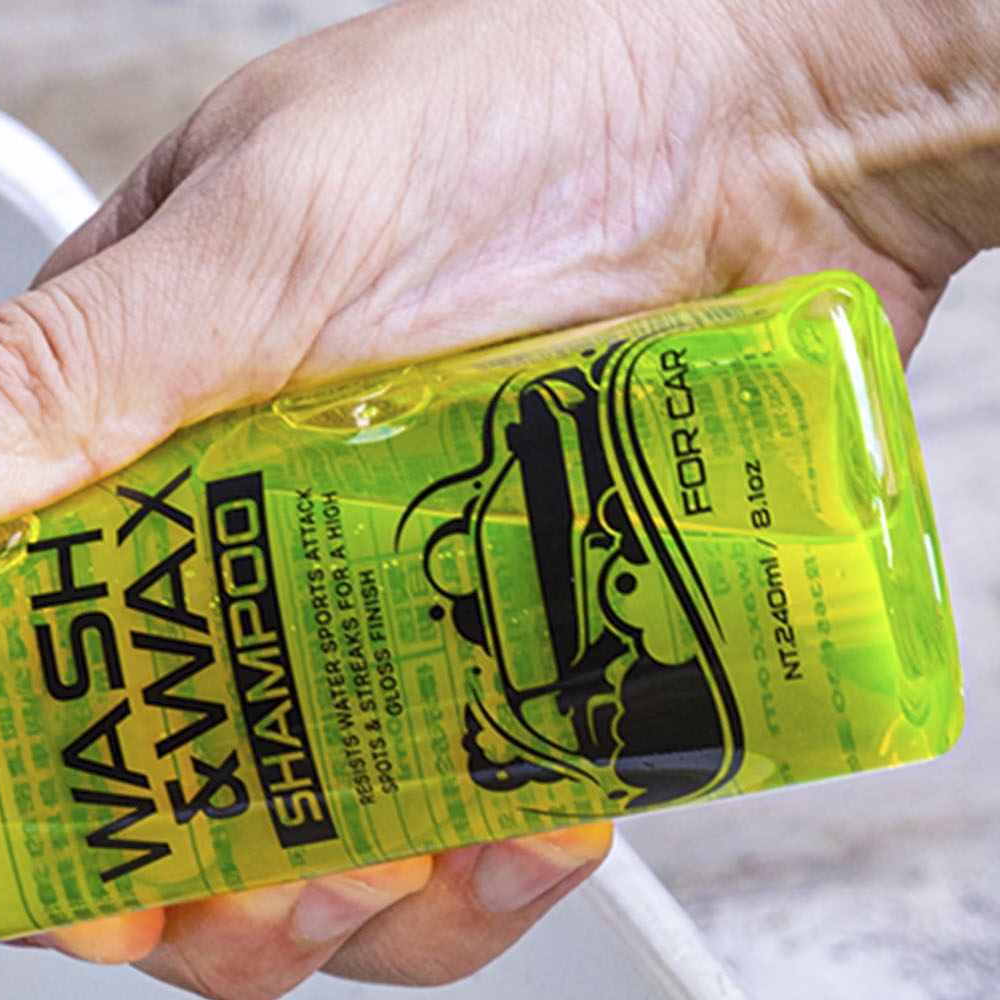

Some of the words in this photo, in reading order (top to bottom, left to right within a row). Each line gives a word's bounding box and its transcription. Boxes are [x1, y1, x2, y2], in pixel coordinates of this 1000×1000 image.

[660, 347, 697, 421] CAR
[672, 427, 712, 516] FOR
[744, 458, 772, 530] 8.1oz
[296, 488, 321, 562] ATTACK
[321, 490, 344, 541] HIGH
[330, 546, 347, 561] A
[334, 570, 353, 611] FOR
[309, 568, 337, 656] SPORTS
[359, 569, 385, 643] FINISH
[765, 556, 804, 681] NT.240ml
[214, 498, 324, 828] SHAMPOO
[324, 662, 354, 731] WATER
[347, 617, 376, 713] STREAKS
[376, 649, 403, 716] GLOSS
[27, 529, 172, 883] WASH
[364, 719, 381, 733] &
[343, 732, 374, 807] RESISTS
[366, 735, 398, 795] SPOTS
